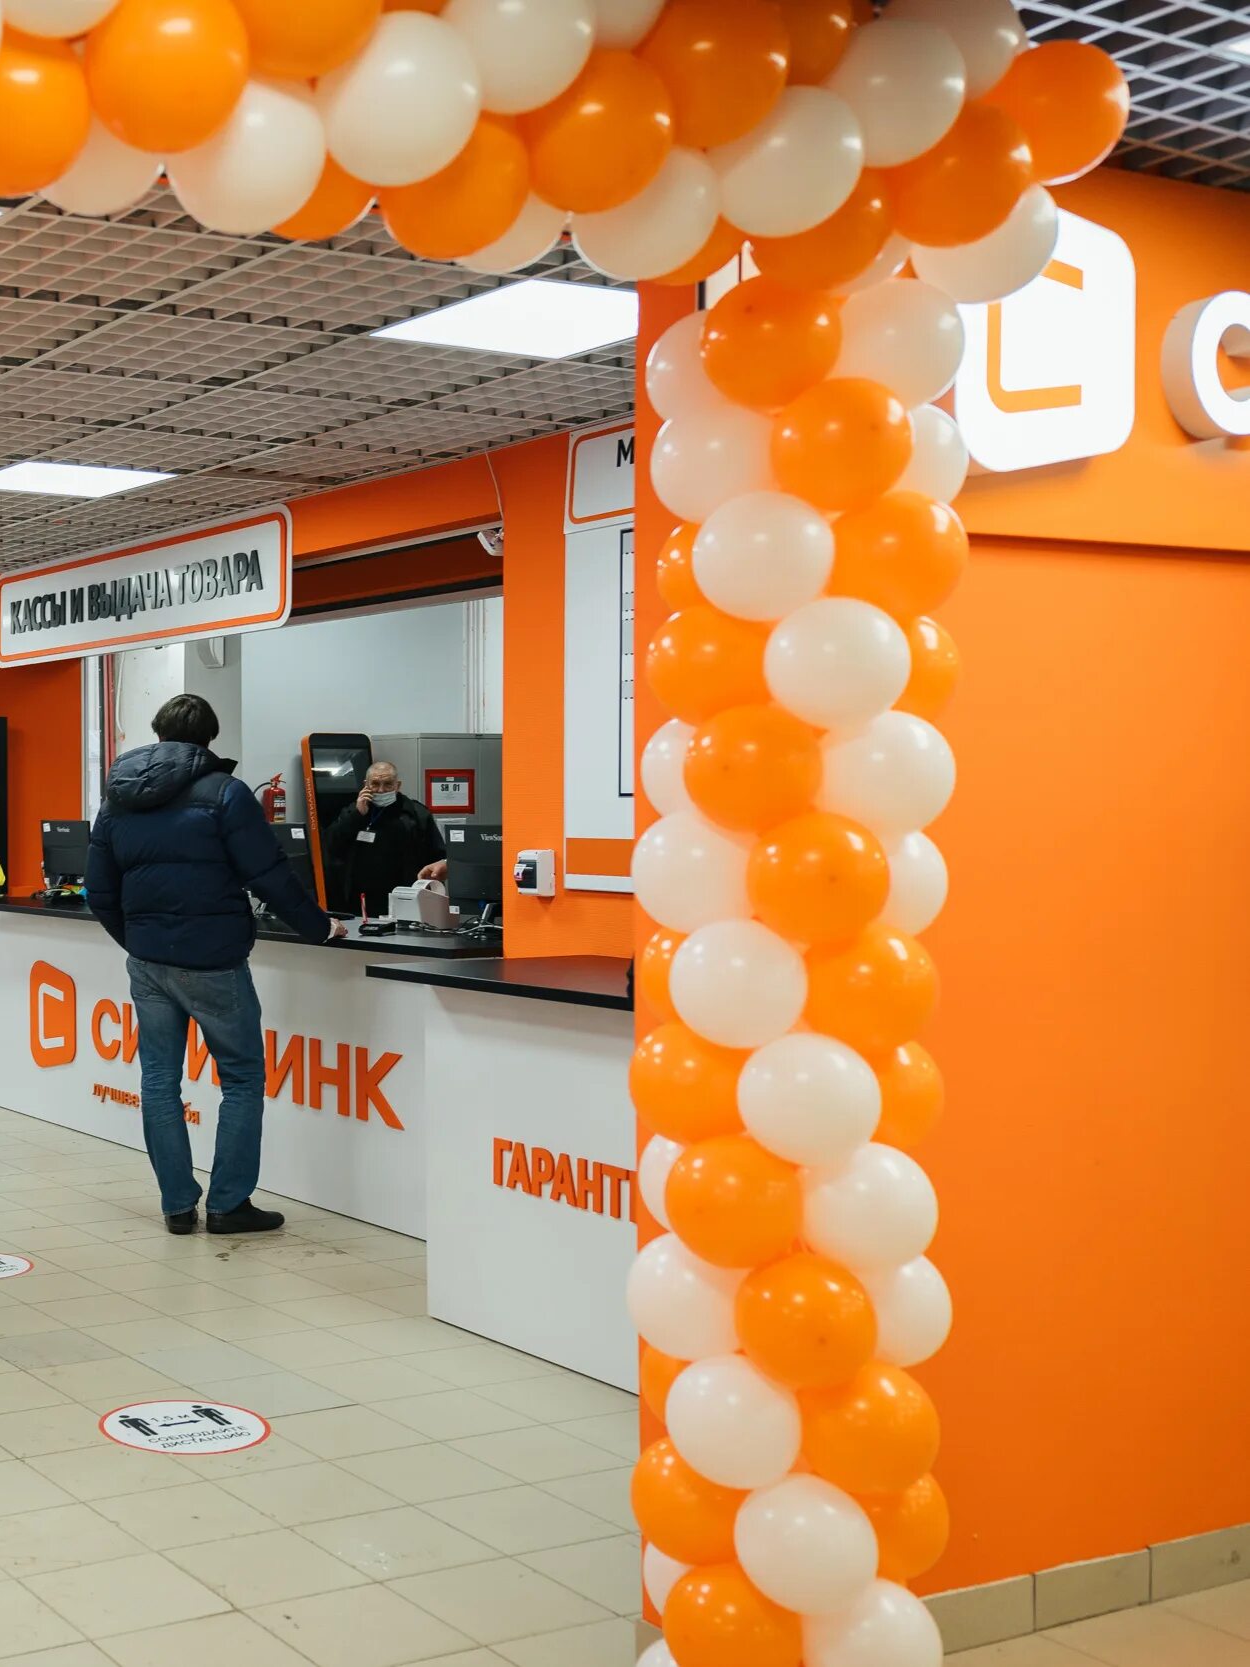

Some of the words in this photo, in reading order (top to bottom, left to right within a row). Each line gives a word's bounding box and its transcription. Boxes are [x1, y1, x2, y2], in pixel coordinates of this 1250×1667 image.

[10, 591, 67, 635] КАССЫ
[70, 587, 84, 624] И
[87, 568, 172, 622] ВЫДАЧА
[174, 549, 264, 605] ТОВАРА
[91, 998, 405, 1132] СИИИНК
[93, 1083, 140, 1108] лучшее
[148, 1425, 249, 1444] СОБЛЮДАЙТЕ
[160, 1431, 251, 1449] ДИСТАНЦИЮ
